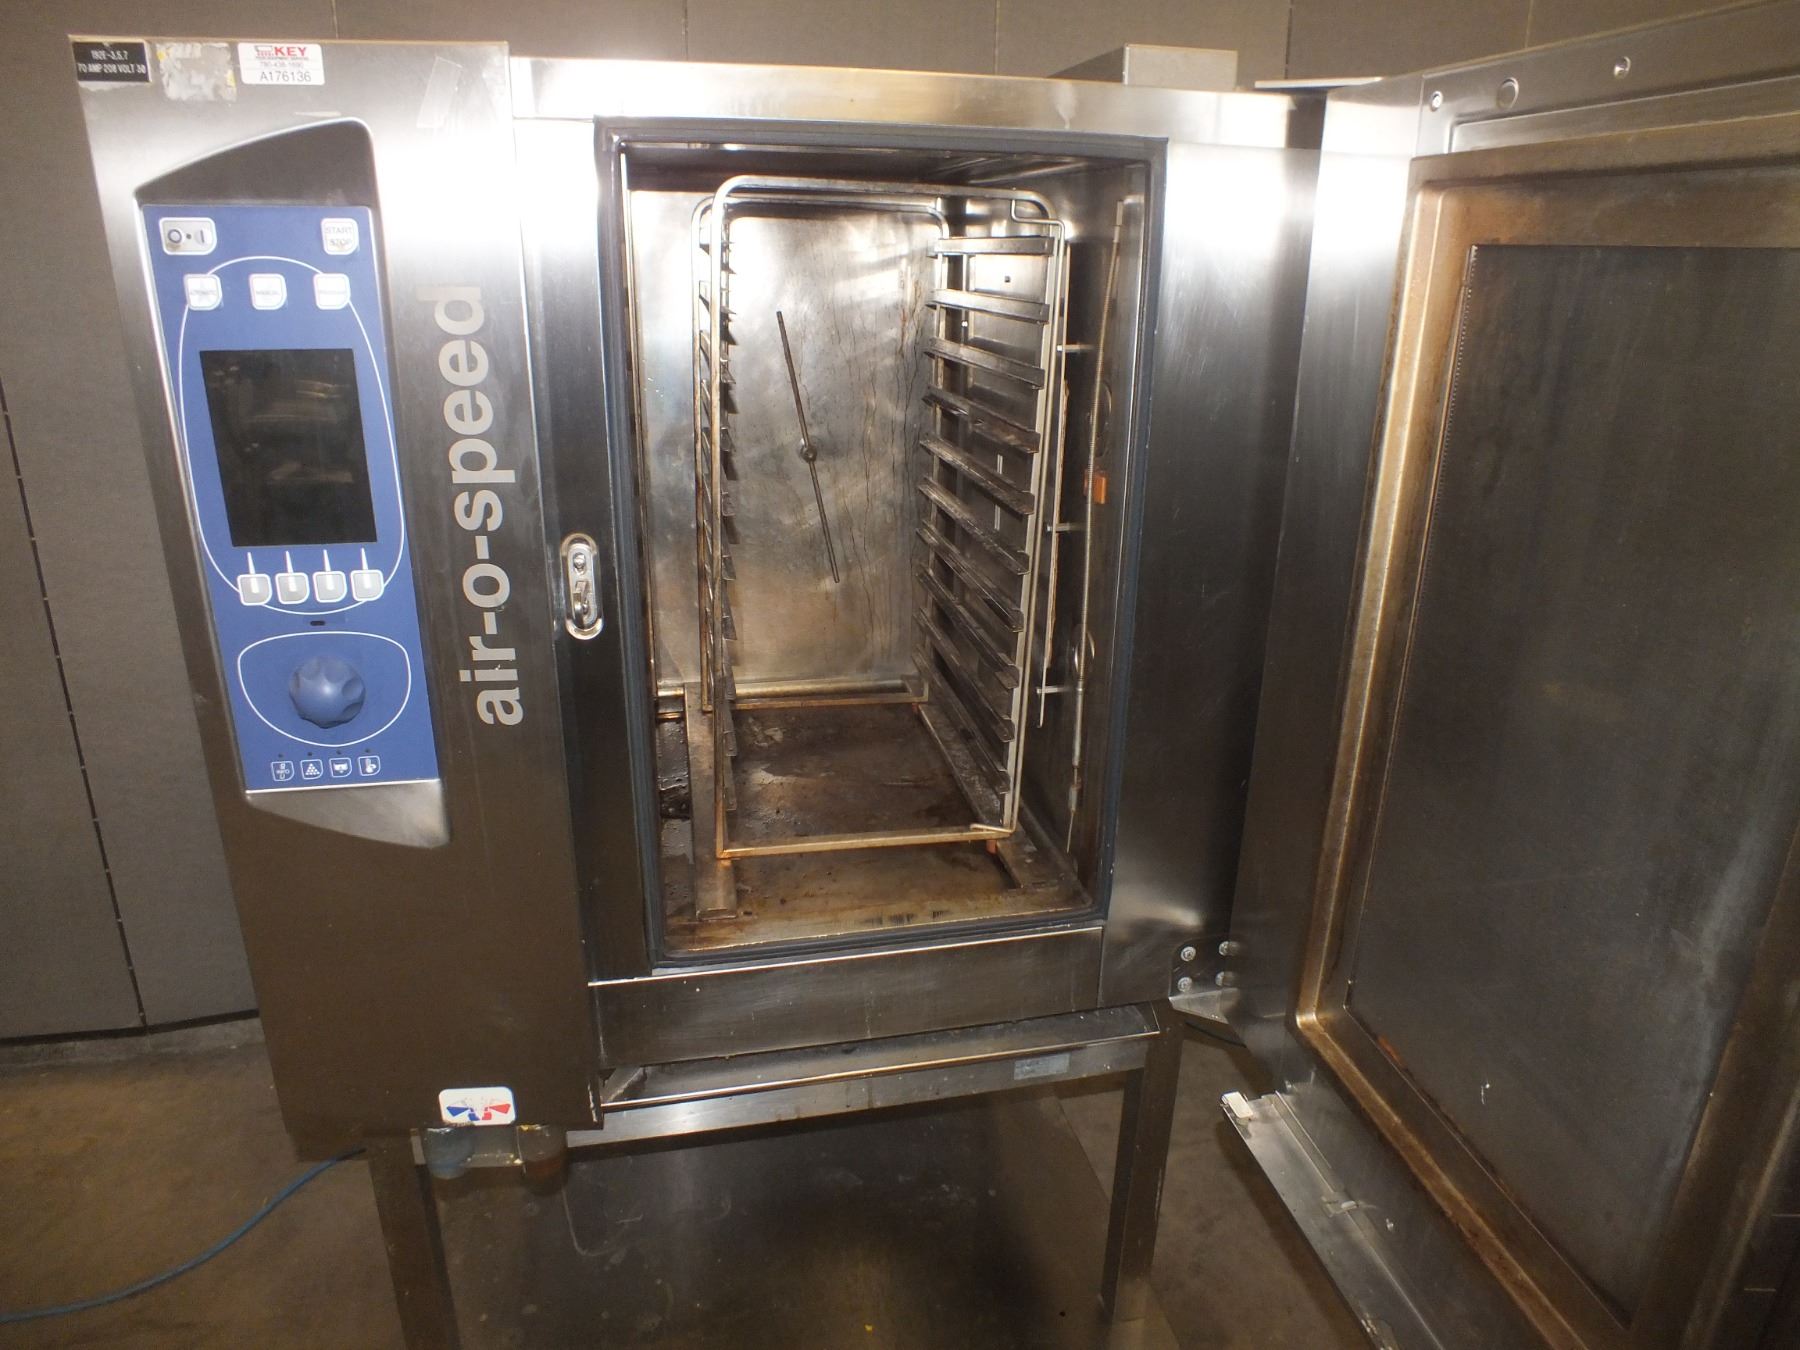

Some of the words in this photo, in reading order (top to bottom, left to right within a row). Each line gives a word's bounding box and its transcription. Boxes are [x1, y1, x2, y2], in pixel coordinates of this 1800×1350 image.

[117, 64, 135, 73] VOLT
[260, 71, 312, 83] A176136
[416, 286, 524, 727] air-o-speed
